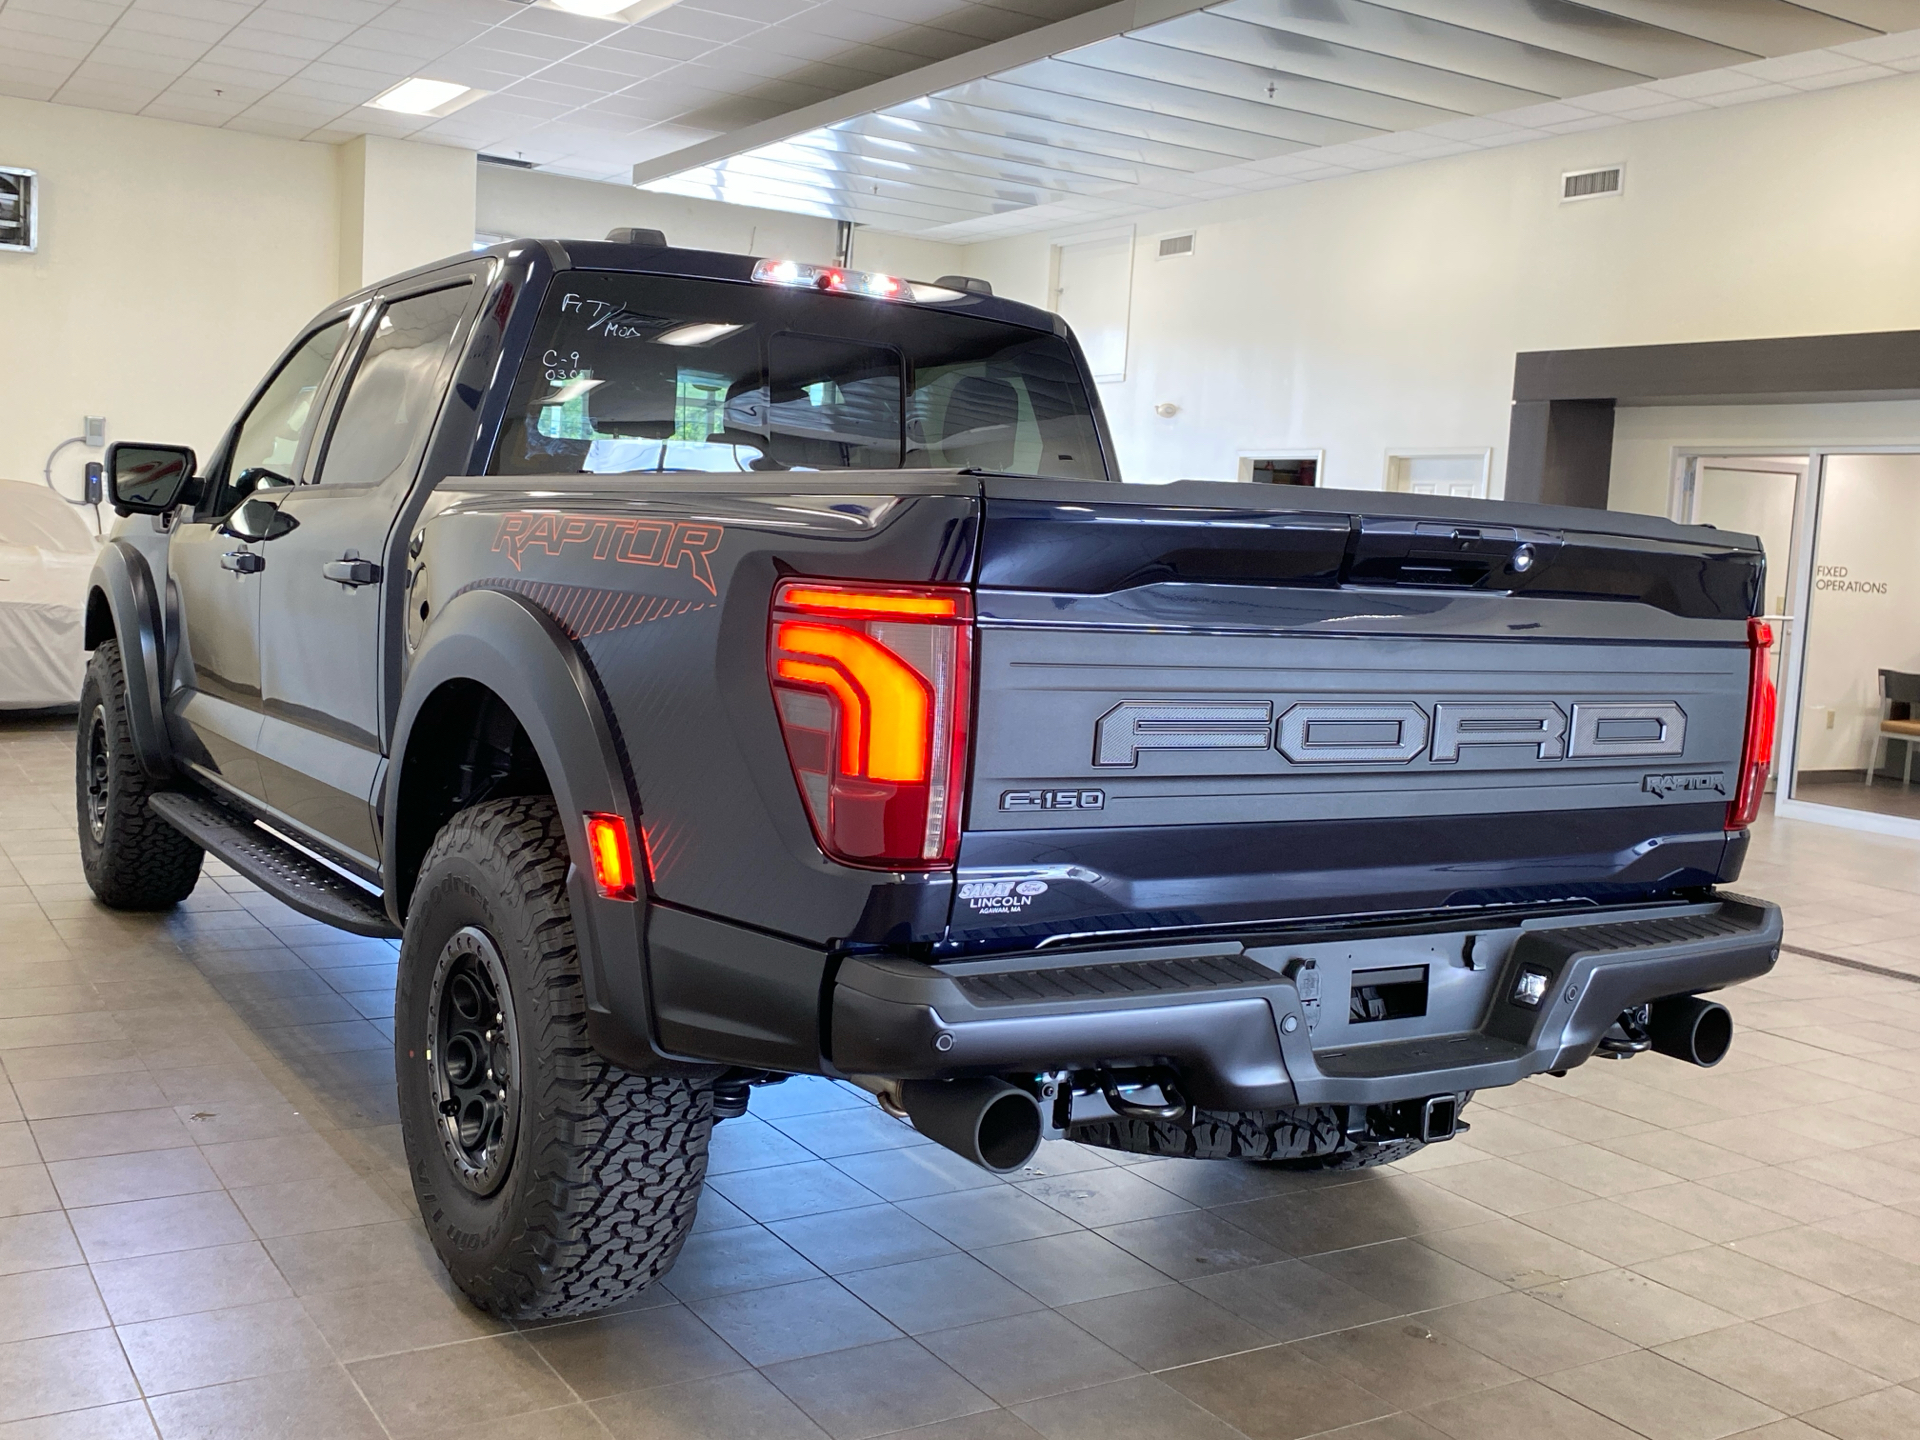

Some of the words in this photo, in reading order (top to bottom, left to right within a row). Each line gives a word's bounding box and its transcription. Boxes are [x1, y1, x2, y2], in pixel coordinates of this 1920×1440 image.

[542, 349, 580, 368] C-9
[491, 512, 725, 597] RAPTOR
[1816, 565, 1848, 578] FIXED
[1815, 579, 1888, 594] OPERATIONS
[1091, 699, 1688, 769] FORD
[1642, 771, 1726, 799] RAPTOR
[999, 788, 1106, 812] F-150
[959, 881, 1015, 899] SARAT
[970, 896, 1032, 908] LINCOLN
